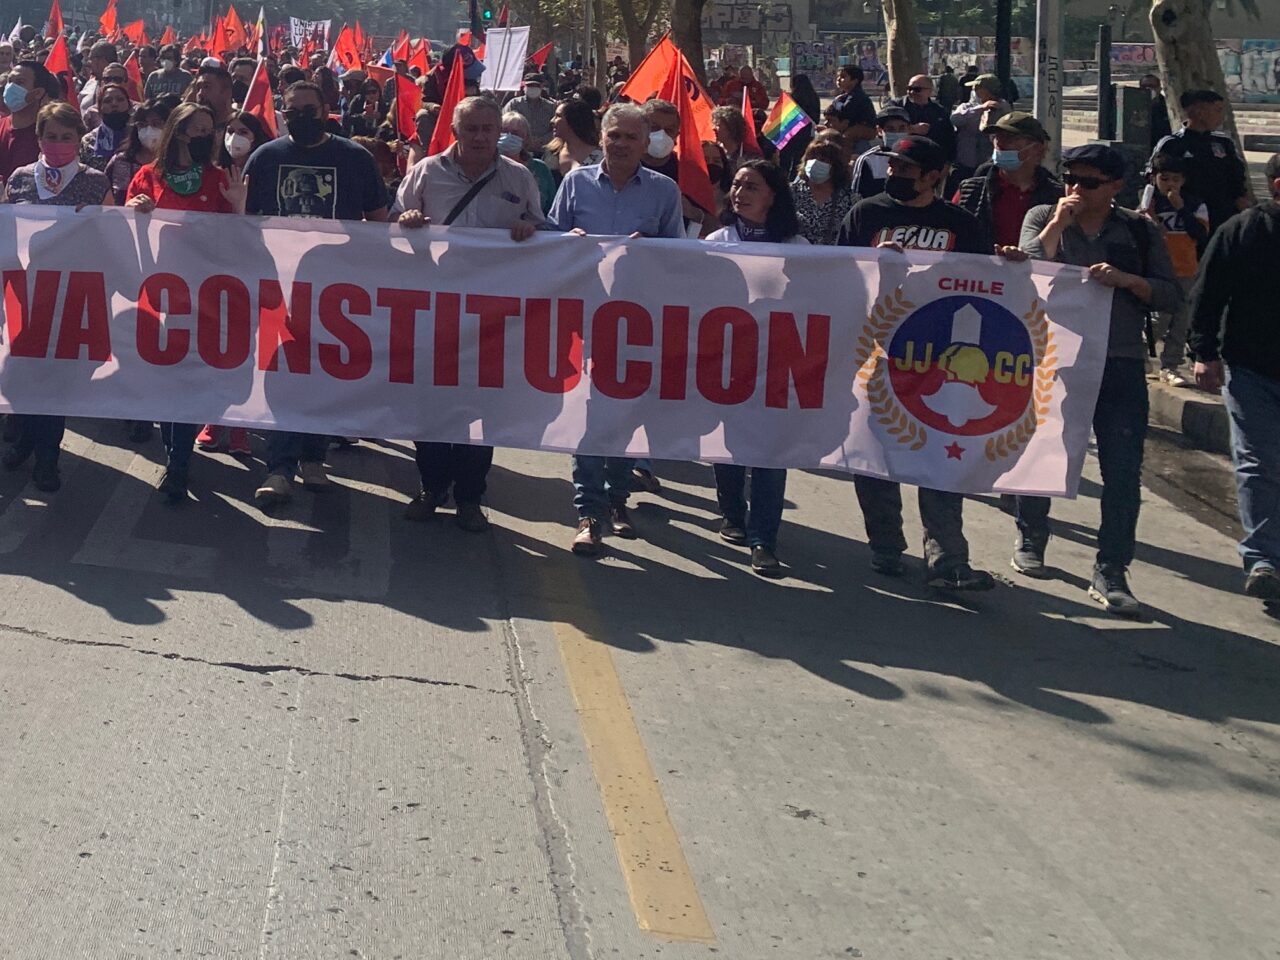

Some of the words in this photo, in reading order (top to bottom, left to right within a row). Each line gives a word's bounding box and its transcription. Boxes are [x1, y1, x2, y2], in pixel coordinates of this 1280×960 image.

[879, 226, 950, 250] LEGUA
[938, 277, 1005, 296] CHILE
[135, 272, 831, 410] CONSTITUCION
[895, 341, 933, 373] JJ
[994, 351, 1031, 386] CC
